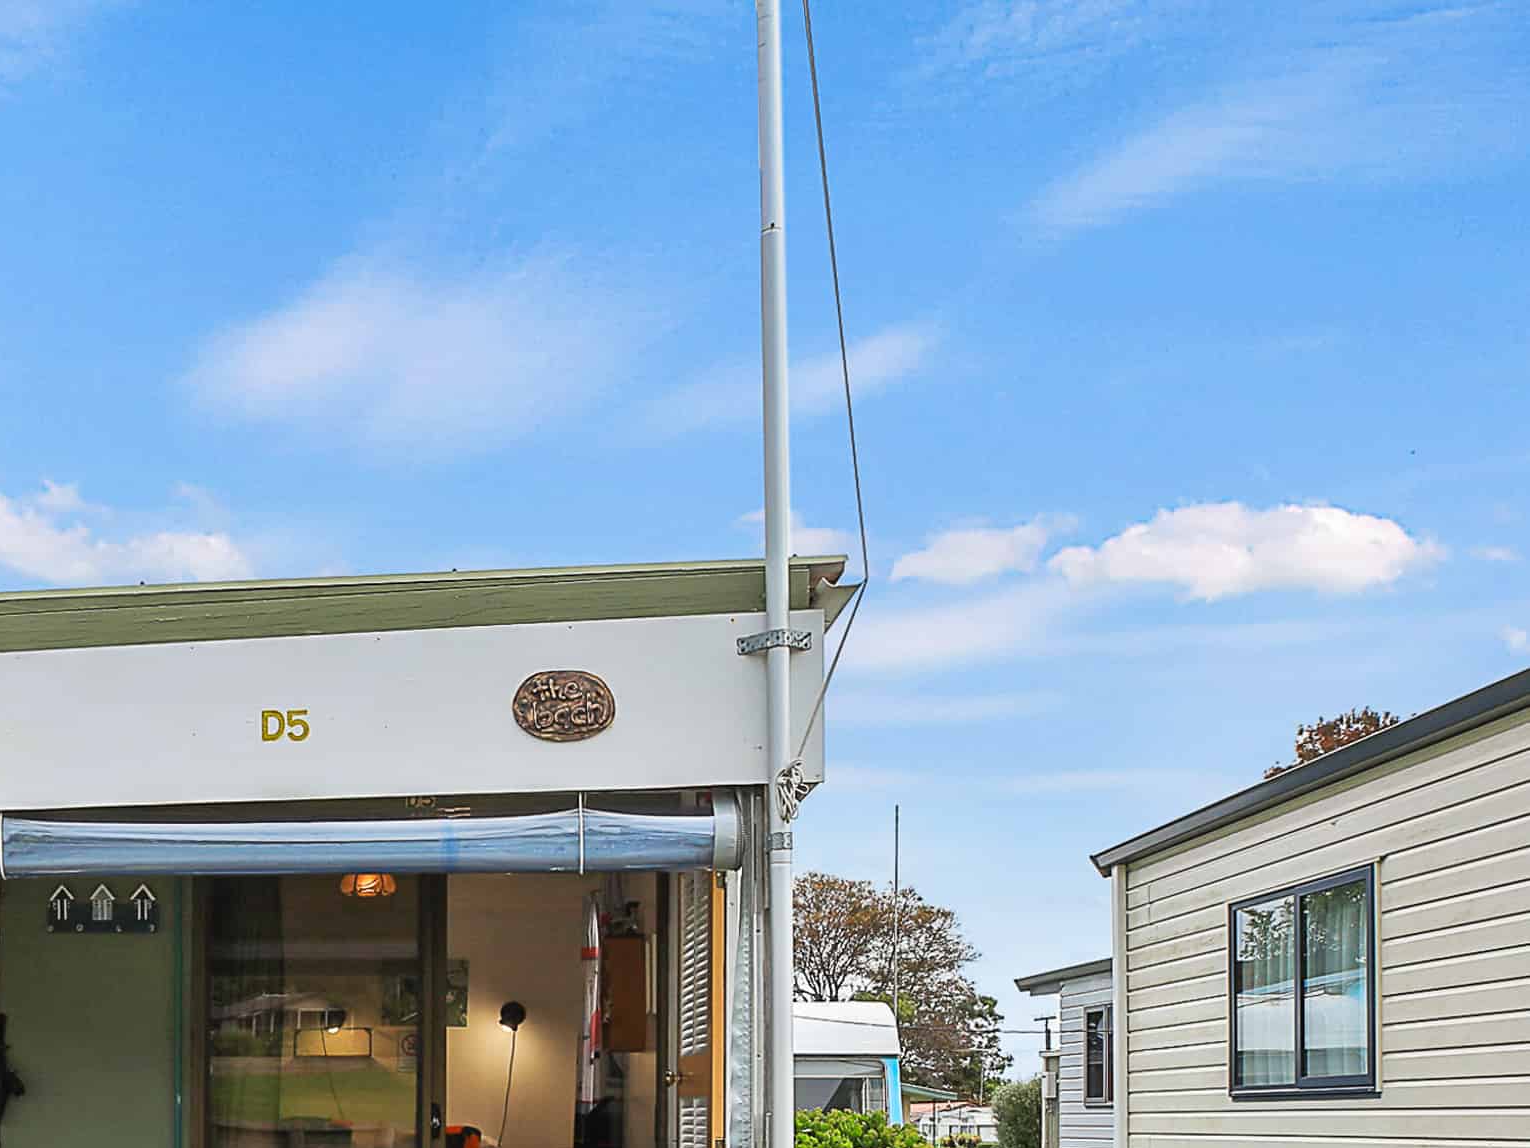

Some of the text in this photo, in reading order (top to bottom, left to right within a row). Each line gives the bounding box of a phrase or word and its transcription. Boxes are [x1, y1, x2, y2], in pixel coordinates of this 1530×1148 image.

[532, 678, 582, 700] the
[261, 709, 310, 742] D5
[532, 693, 607, 729] bach
